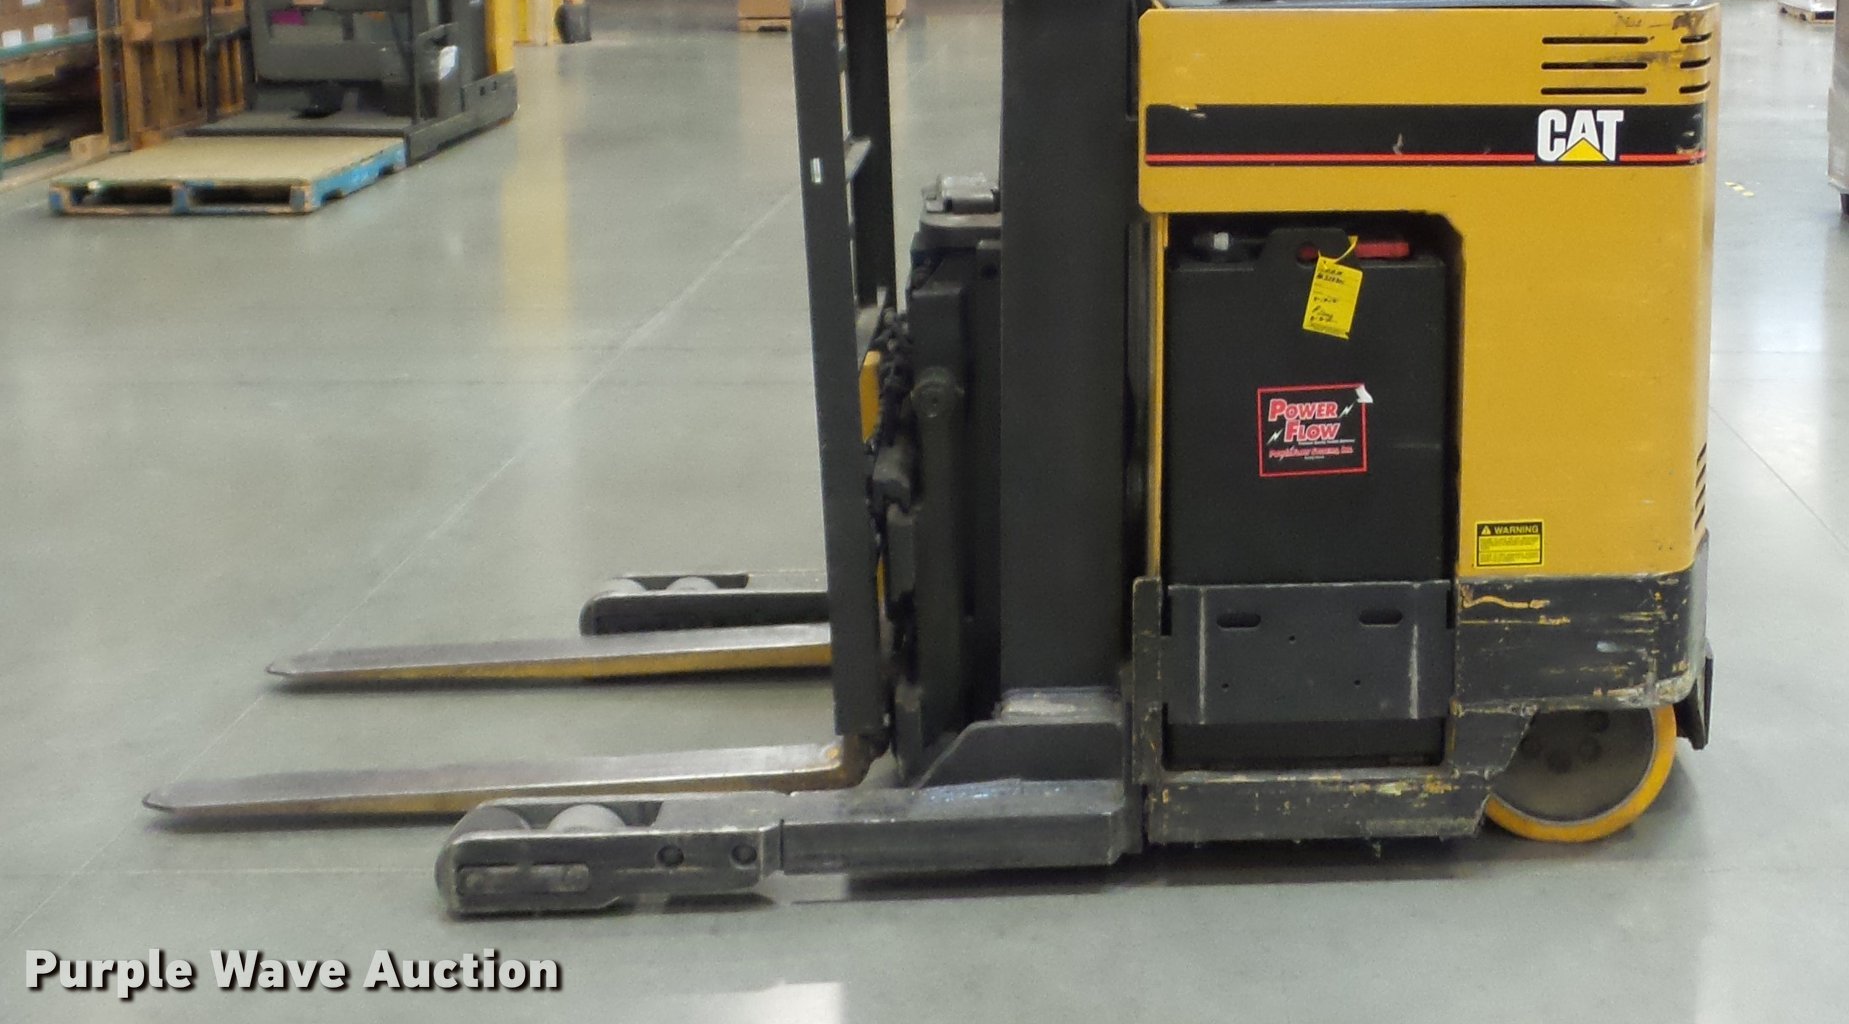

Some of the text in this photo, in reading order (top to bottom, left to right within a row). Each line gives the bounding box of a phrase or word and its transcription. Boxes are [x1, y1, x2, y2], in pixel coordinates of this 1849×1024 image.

[1537, 108, 1624, 162] CAT
[1267, 398, 1338, 422] POWER
[1283, 419, 1340, 443] FLOW
[1494, 524, 1539, 535] WARNING
